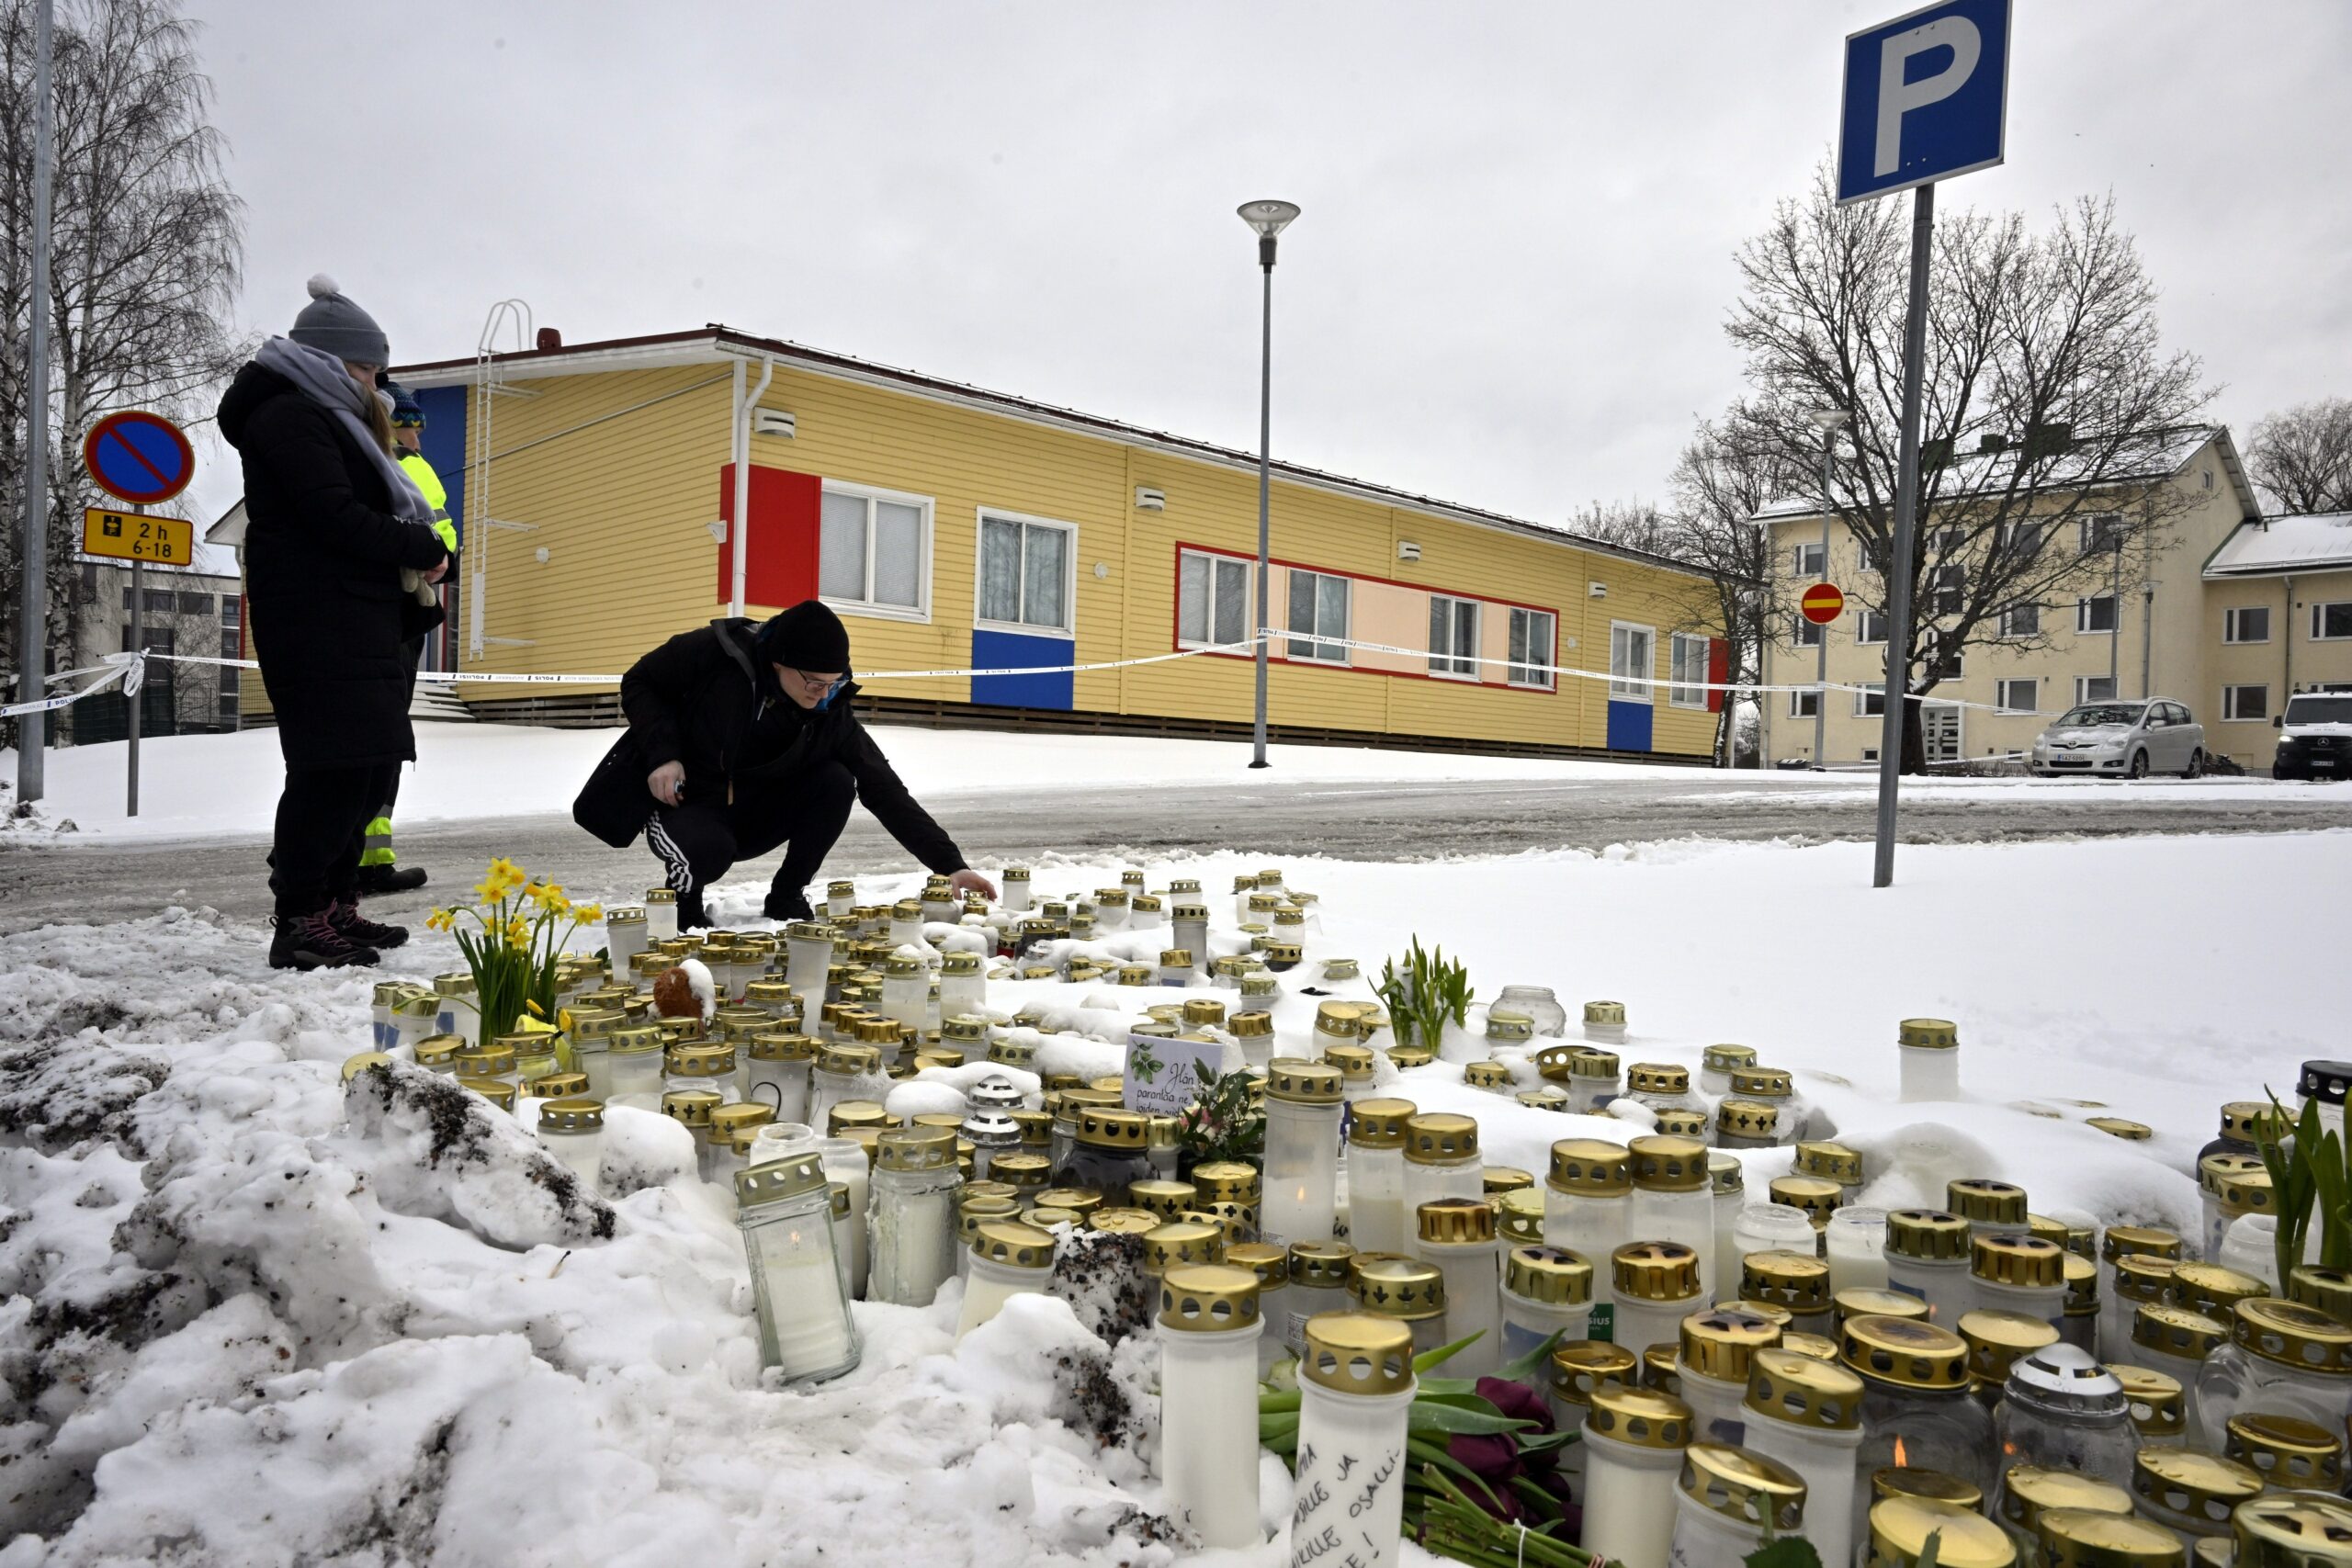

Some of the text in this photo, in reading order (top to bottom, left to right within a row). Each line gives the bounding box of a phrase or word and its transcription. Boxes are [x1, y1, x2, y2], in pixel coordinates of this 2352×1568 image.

[1873, 15, 1982, 179] P
[140, 523, 151, 539] 2
[157, 525, 168, 541] h
[132, 540, 173, 558] 6-18
[1337, 1454, 1360, 1482] JA
